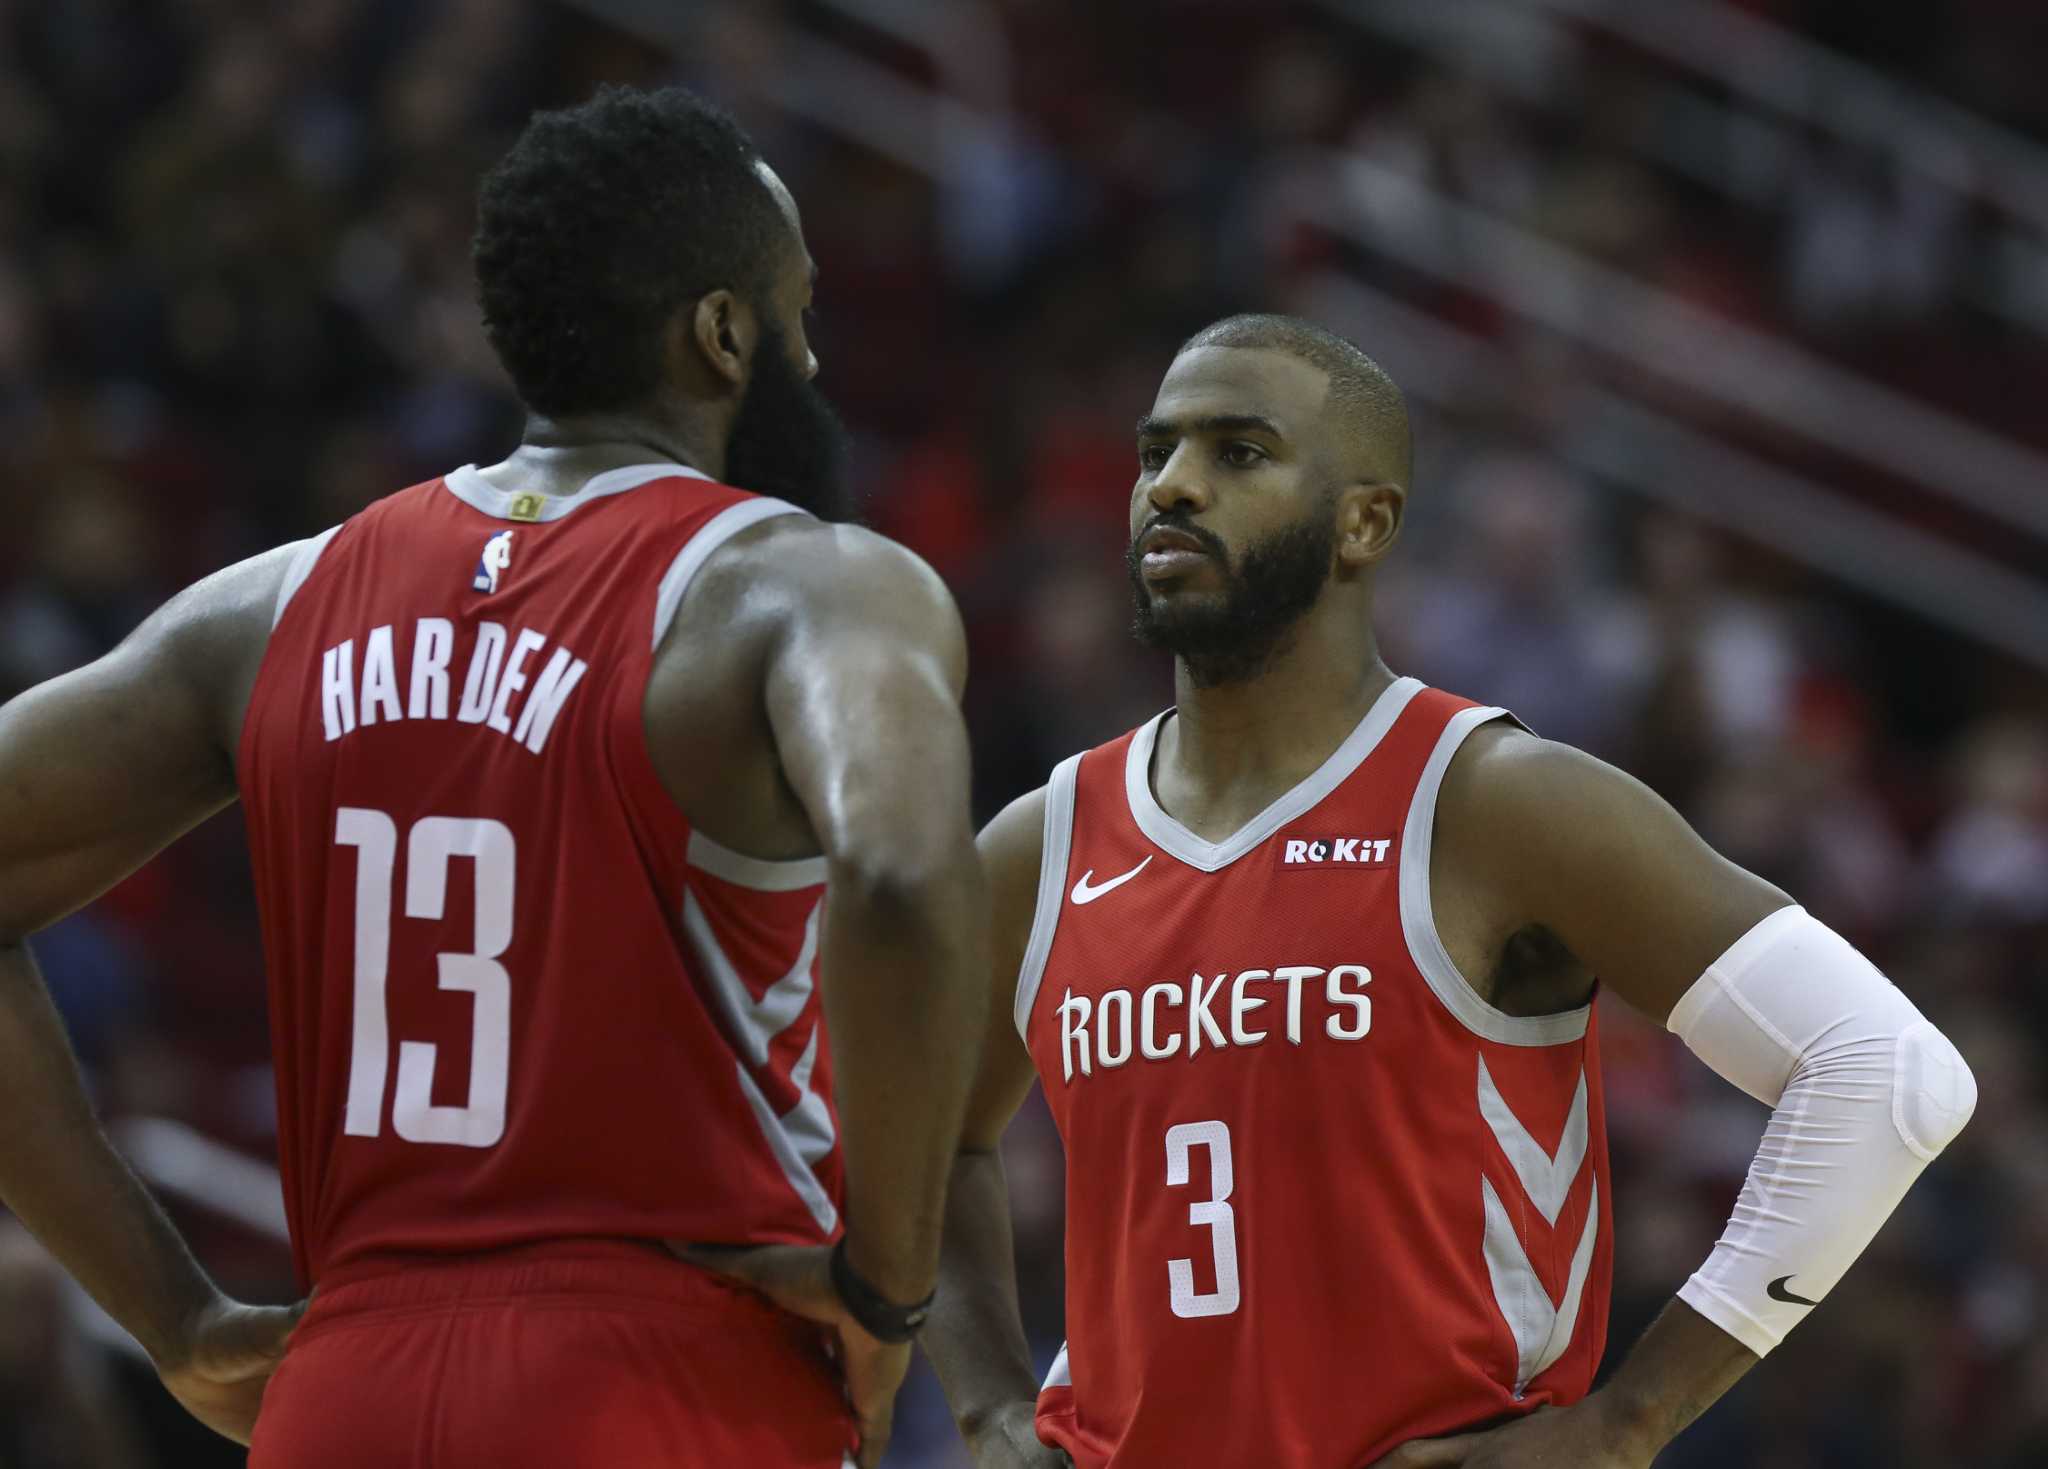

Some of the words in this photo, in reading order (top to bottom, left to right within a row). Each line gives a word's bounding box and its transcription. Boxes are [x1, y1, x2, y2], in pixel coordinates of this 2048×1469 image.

[321, 617, 588, 755] HARDEN
[335, 807, 516, 1148] 13
[1055, 964, 1373, 1085] ROCKETS
[1165, 1120, 1240, 1318] 3
